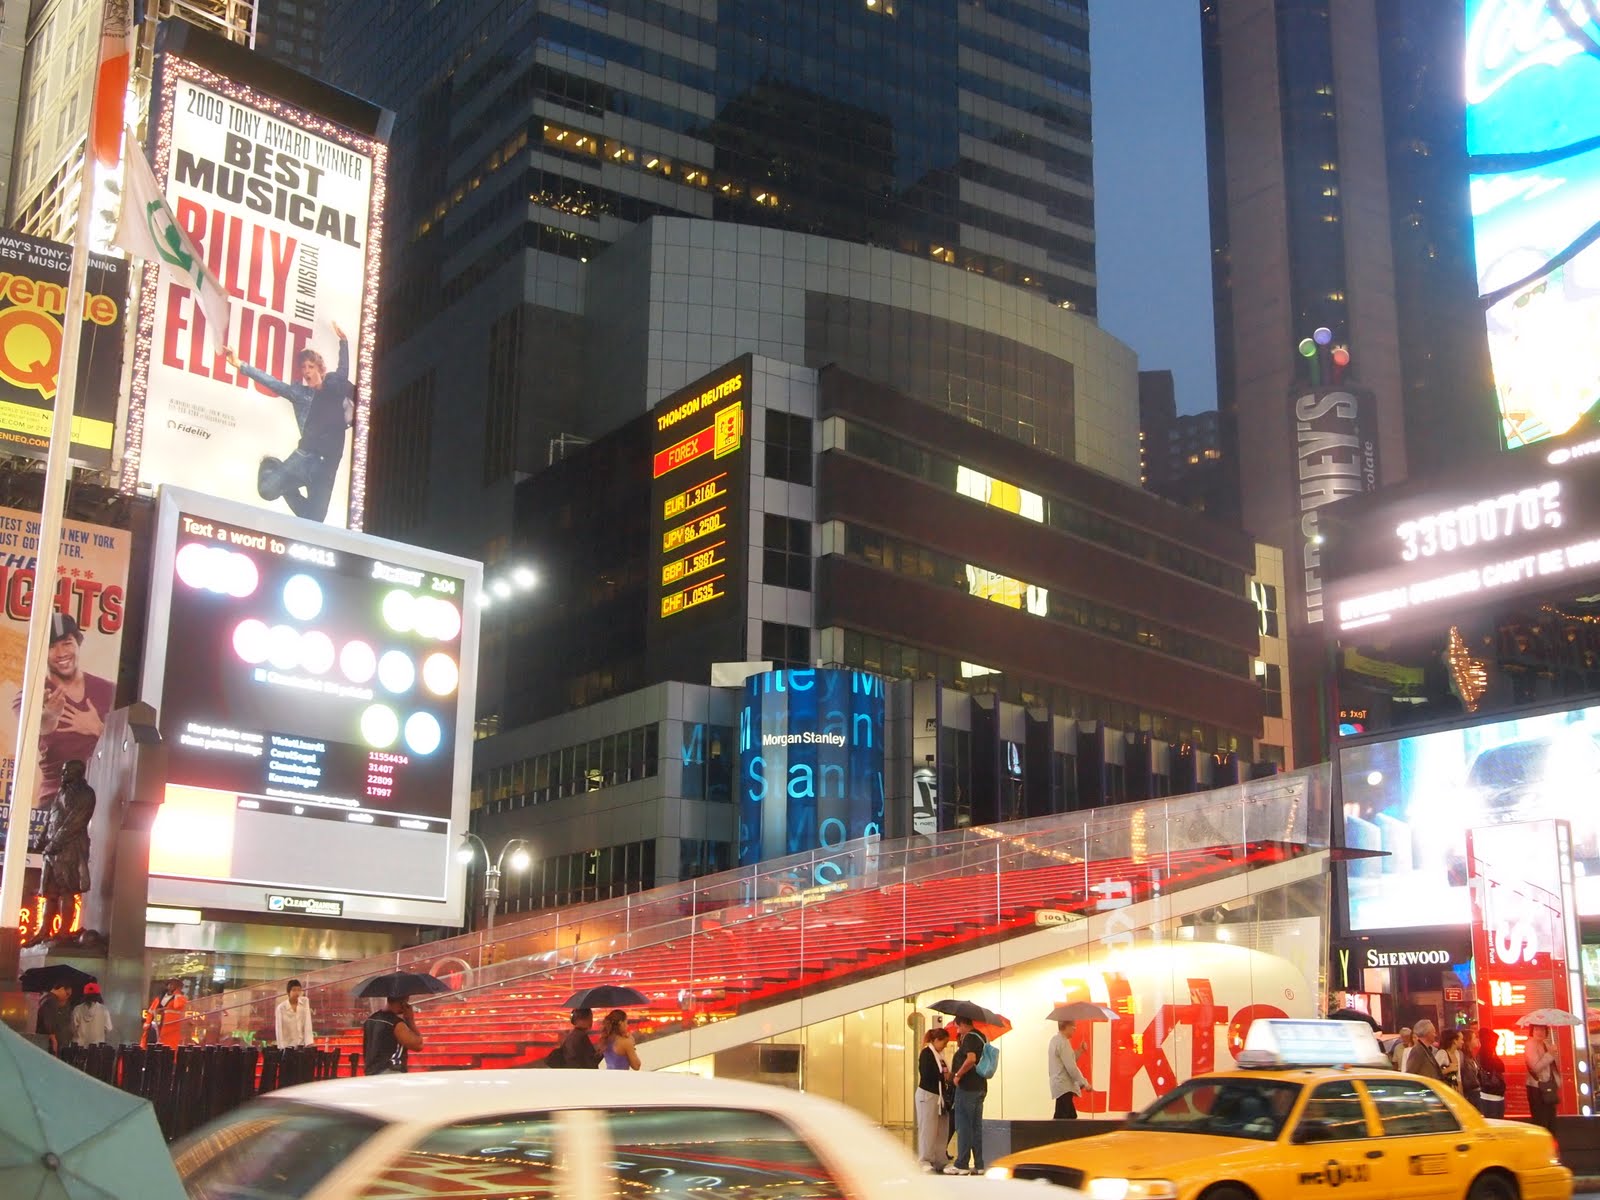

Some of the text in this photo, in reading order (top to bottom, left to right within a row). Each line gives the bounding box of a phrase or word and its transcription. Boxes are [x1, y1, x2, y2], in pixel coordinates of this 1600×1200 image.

[187, 88, 362, 181] 2009 TONY AWARD WINNER
[224, 131, 325, 198] BEST
[175, 148, 362, 249] MUSICAL
[0, 248, 24, 261] EST
[176, 196, 298, 313] BILLY
[295, 242, 321, 322] THE MUSICAL
[657, 374, 742, 431] THOMSON REUTERS
[177, 423, 211, 439] Fidelity
[668, 438, 699, 466] FOREX
[665, 496, 684, 517] EUR
[69, 529, 90, 544] NEW
[93, 533, 115, 549] YORK
[183, 518, 213, 538] Text
[217, 528, 227, 541] a
[230, 530, 267, 550] word
[270, 538, 286, 555] to
[664, 529, 683, 549] JPY
[663, 562, 683, 583] GBP
[663, 593, 683, 614] CHF
[762, 731, 846, 747] Morgan Stanley
[368, 763, 393, 774] 31407
[367, 775, 393, 786] 22809
[366, 786, 391, 798] 17997
[1367, 949, 1450, 967] SHERWOOD
